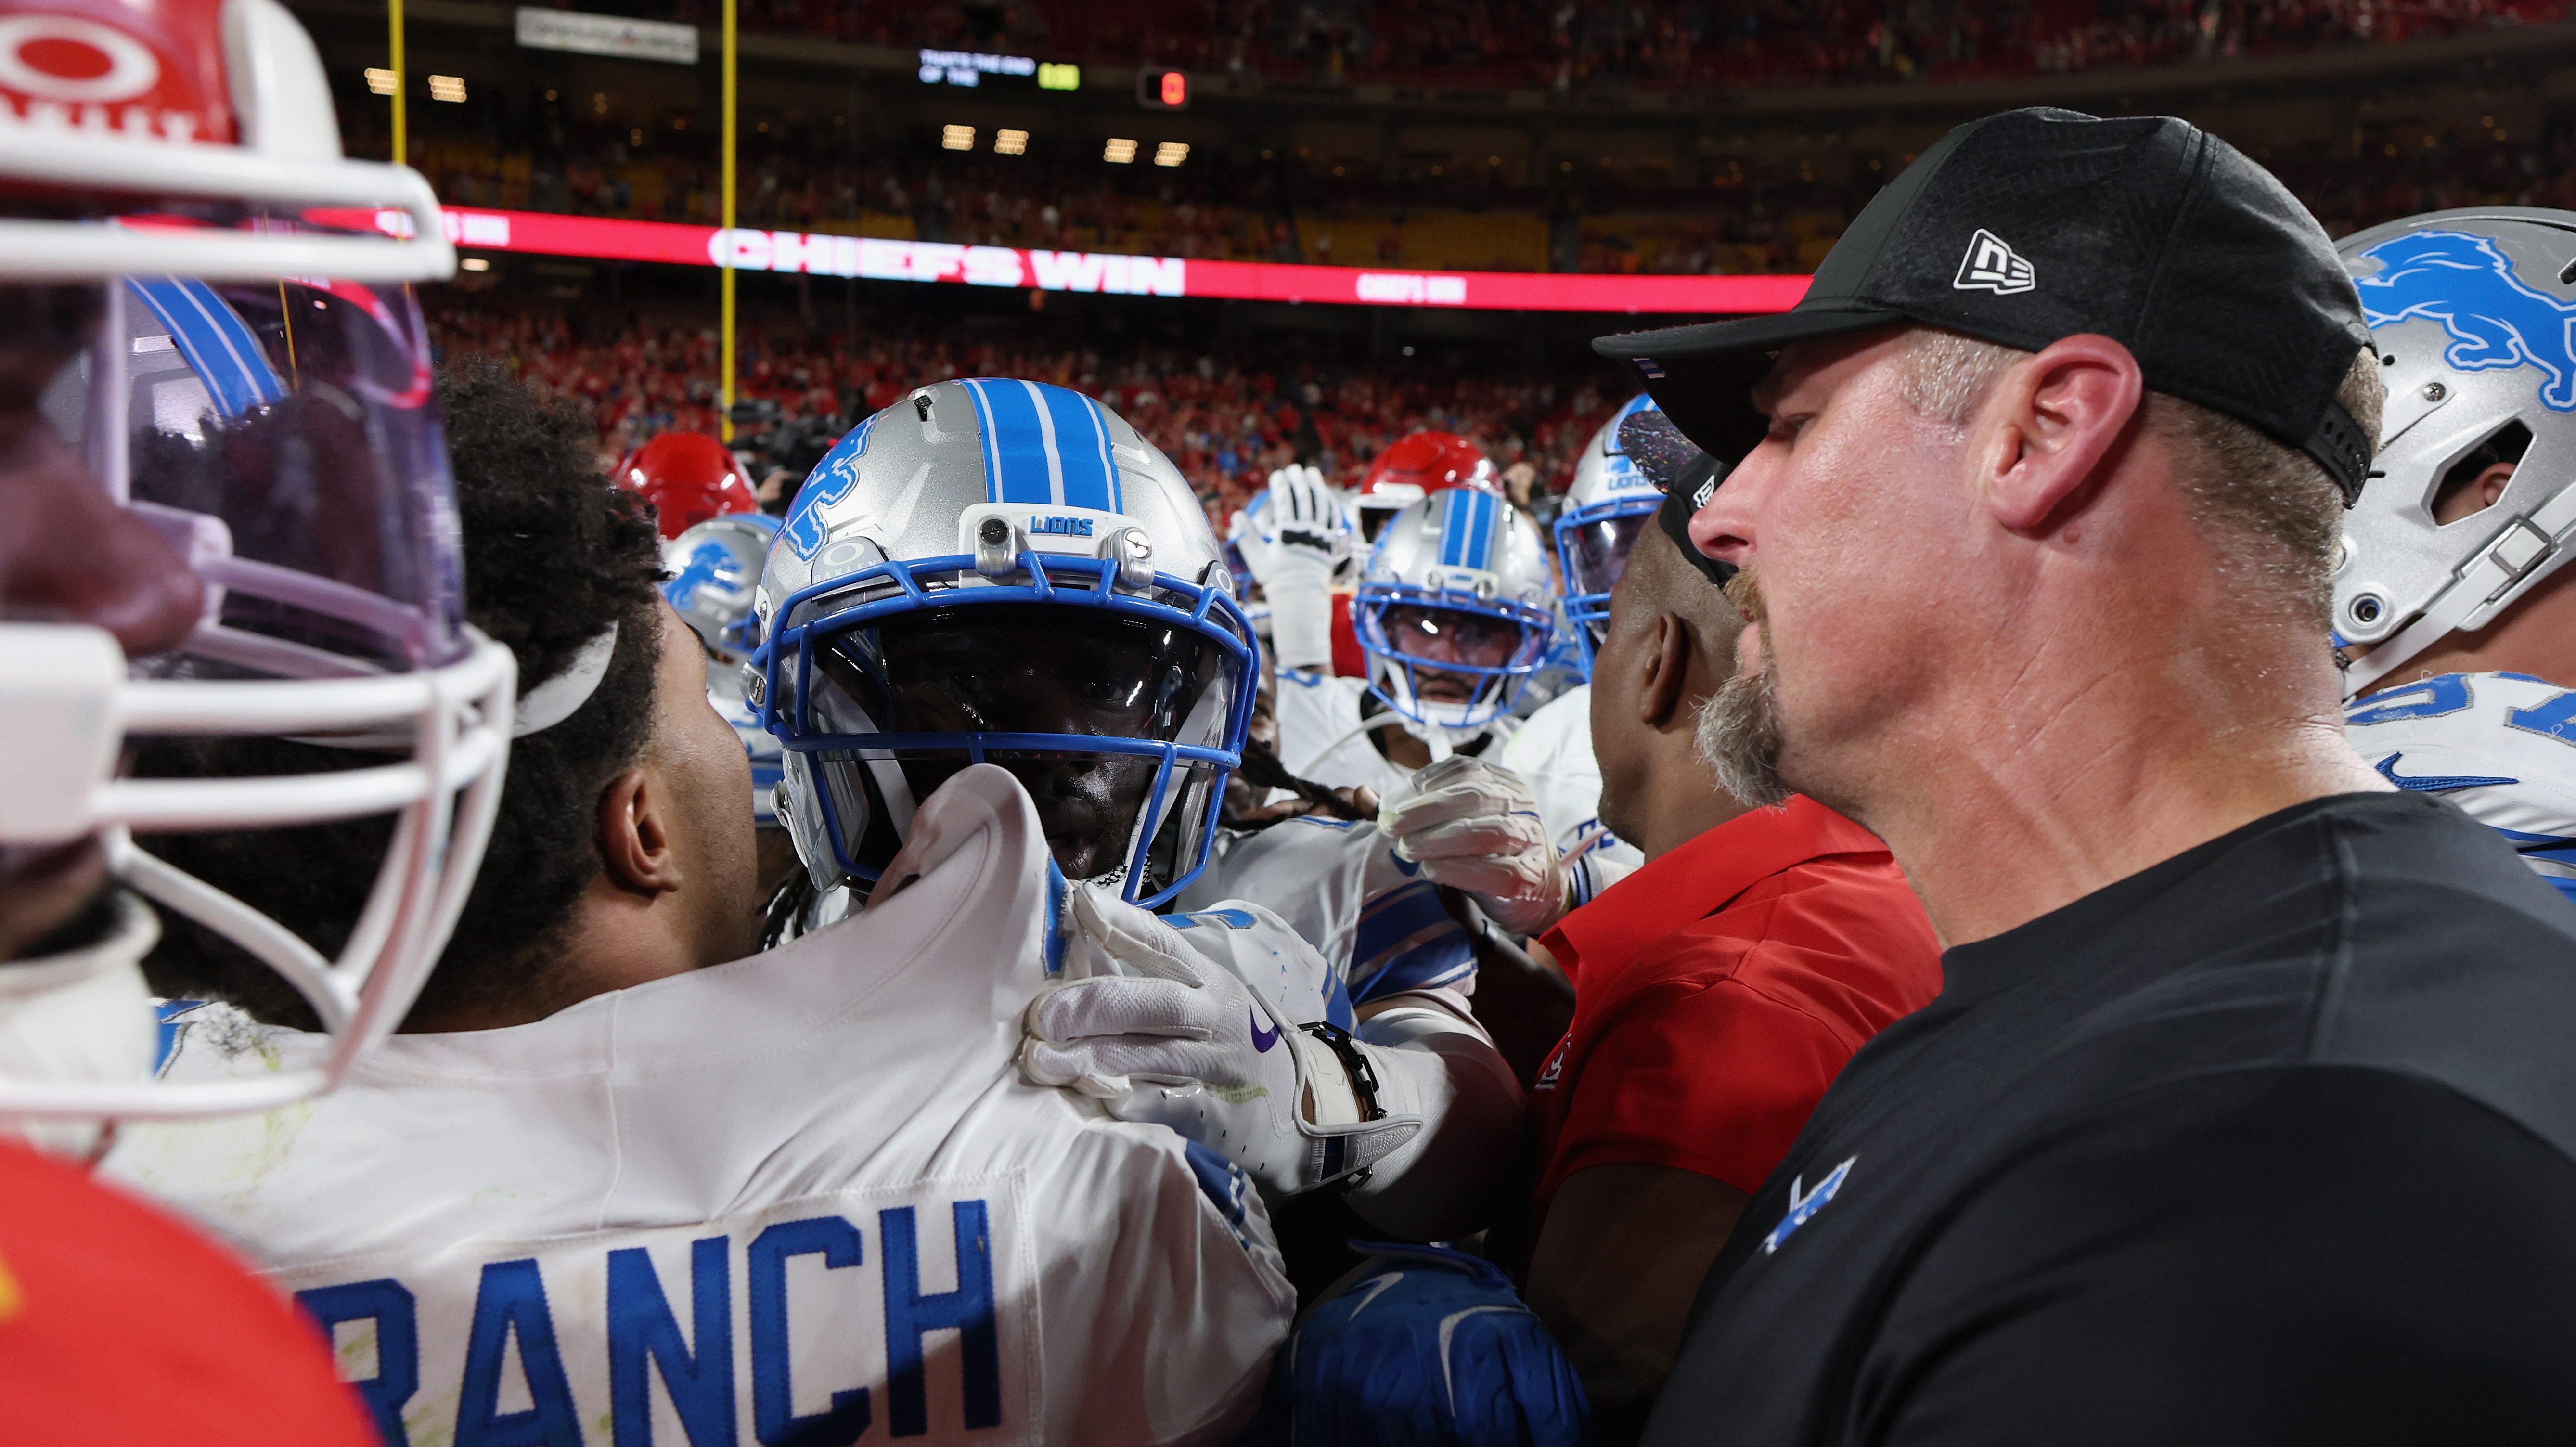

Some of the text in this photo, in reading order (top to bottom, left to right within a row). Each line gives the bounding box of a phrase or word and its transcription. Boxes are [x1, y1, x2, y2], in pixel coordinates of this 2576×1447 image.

[708, 229, 1185, 297] CHIEFS WIN
[1030, 516, 1093, 536] LIONS
